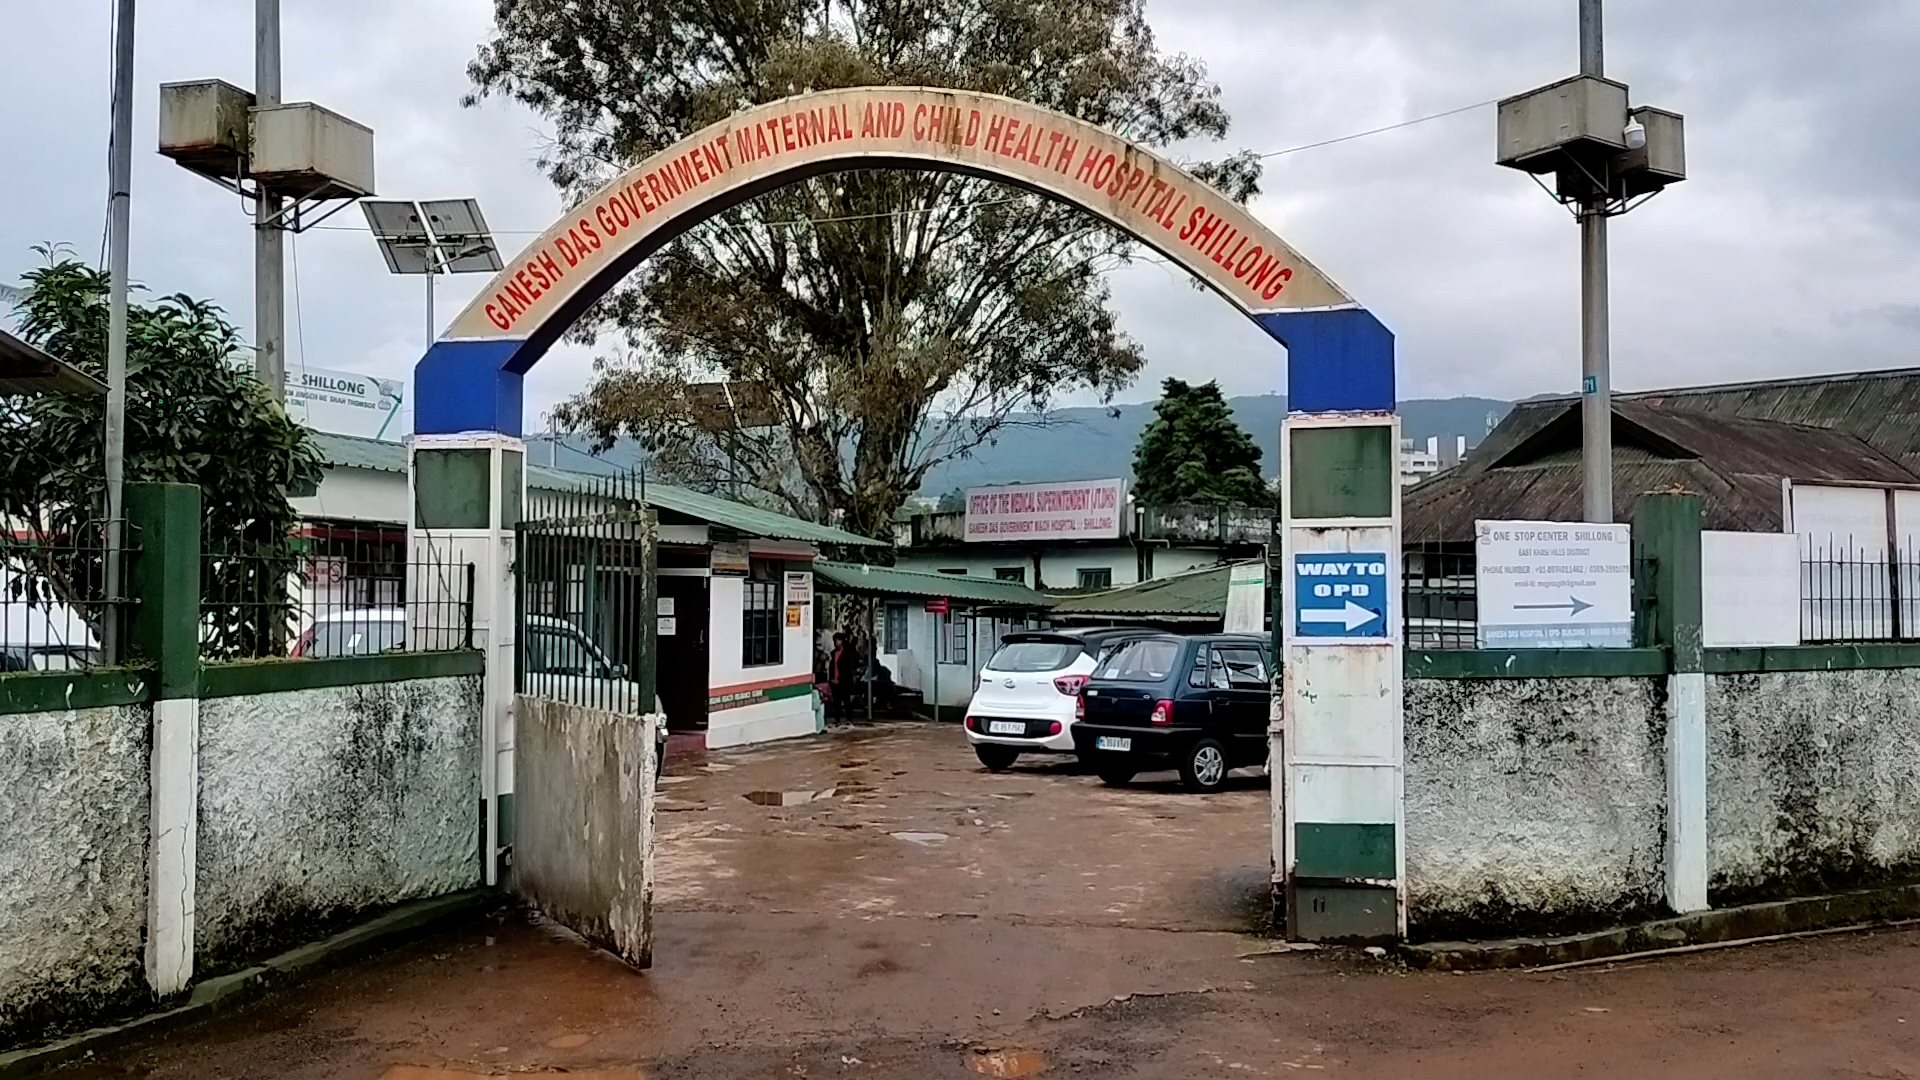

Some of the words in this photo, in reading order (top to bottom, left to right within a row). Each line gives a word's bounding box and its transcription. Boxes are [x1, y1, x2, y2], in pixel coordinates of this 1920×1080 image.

[485, 250, 564, 331] GANESH
[554, 218, 602, 268] DAS
[595, 135, 734, 237] GOVERNMENT
[736, 103, 853, 165] MATERNAL
[861, 101, 905, 138] AND
[913, 103, 981, 147] CHILD
[984, 113, 1079, 175] HEALTH
[1075, 145, 1187, 230] HOSPITAL
[1179, 205, 1293, 300] SHILLONG
[302, 373, 365, 395] SHILLONG
[970, 493, 989, 515] OFFICE
[990, 493, 998, 514] OF
[999, 492, 1010, 514] THE
[1011, 491, 1035, 513] MEDICAL
[968, 522, 988, 534] GANESH
[989, 522, 998, 533] DAS
[1000, 520, 1034, 533] GOVERNMENT
[1051, 519, 1076, 531] HOSPITAL
[1493, 531, 1511, 541] ONE
[1514, 531, 1535, 542] STOP
[1537, 531, 1569, 542] CENTER
[1574, 531, 1613, 542] SHILLONG
[1518, 548, 1532, 557] EAST
[1533, 548, 1550, 557] KHASI
[1550, 548, 1566, 556] HILLS
[1566, 548, 1590, 556] DISTRICT
[1296, 562, 1352, 576] WAY
[1352, 562, 1385, 576] TO
[1482, 565, 1504, 574] PHONE
[1314, 584, 1369, 597] OPD
